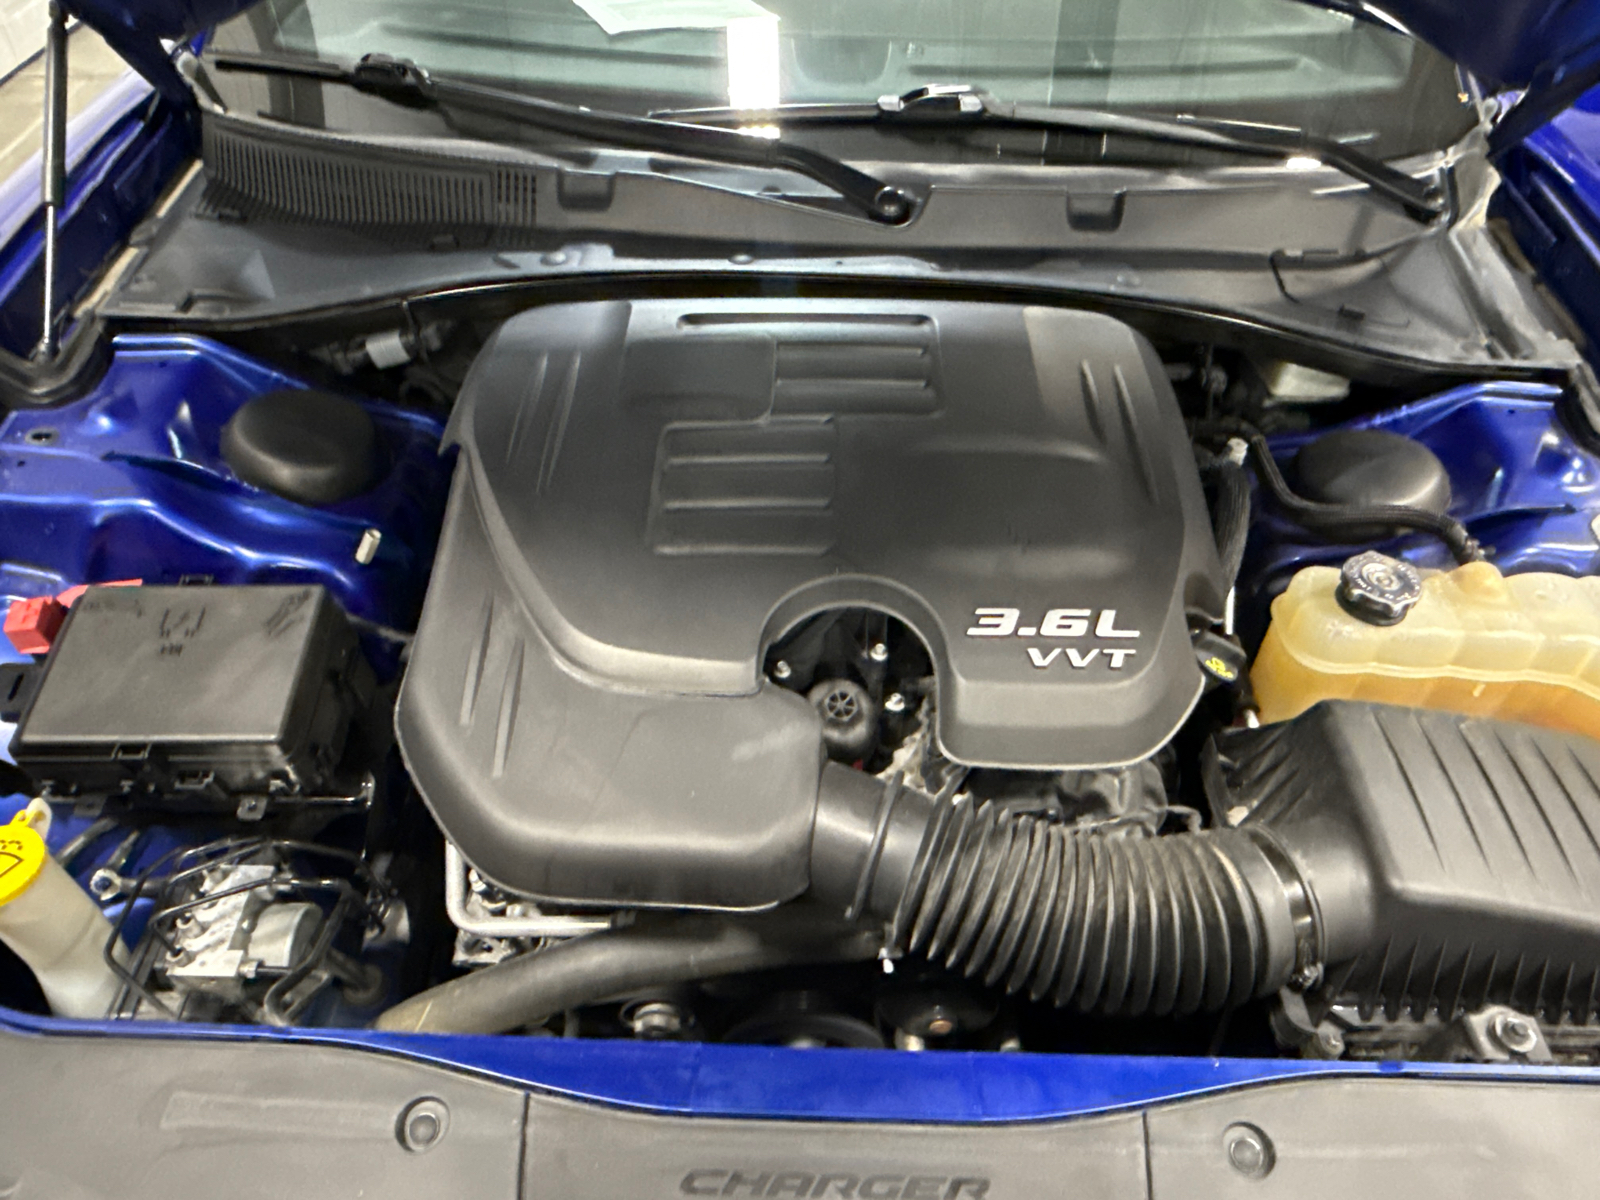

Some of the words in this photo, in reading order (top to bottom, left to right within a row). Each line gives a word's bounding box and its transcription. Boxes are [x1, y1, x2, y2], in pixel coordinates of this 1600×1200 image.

[966, 607, 1141, 638] 3.6L
[1027, 647, 1137, 669] VVT
[679, 1168, 991, 1200] CHARGER
